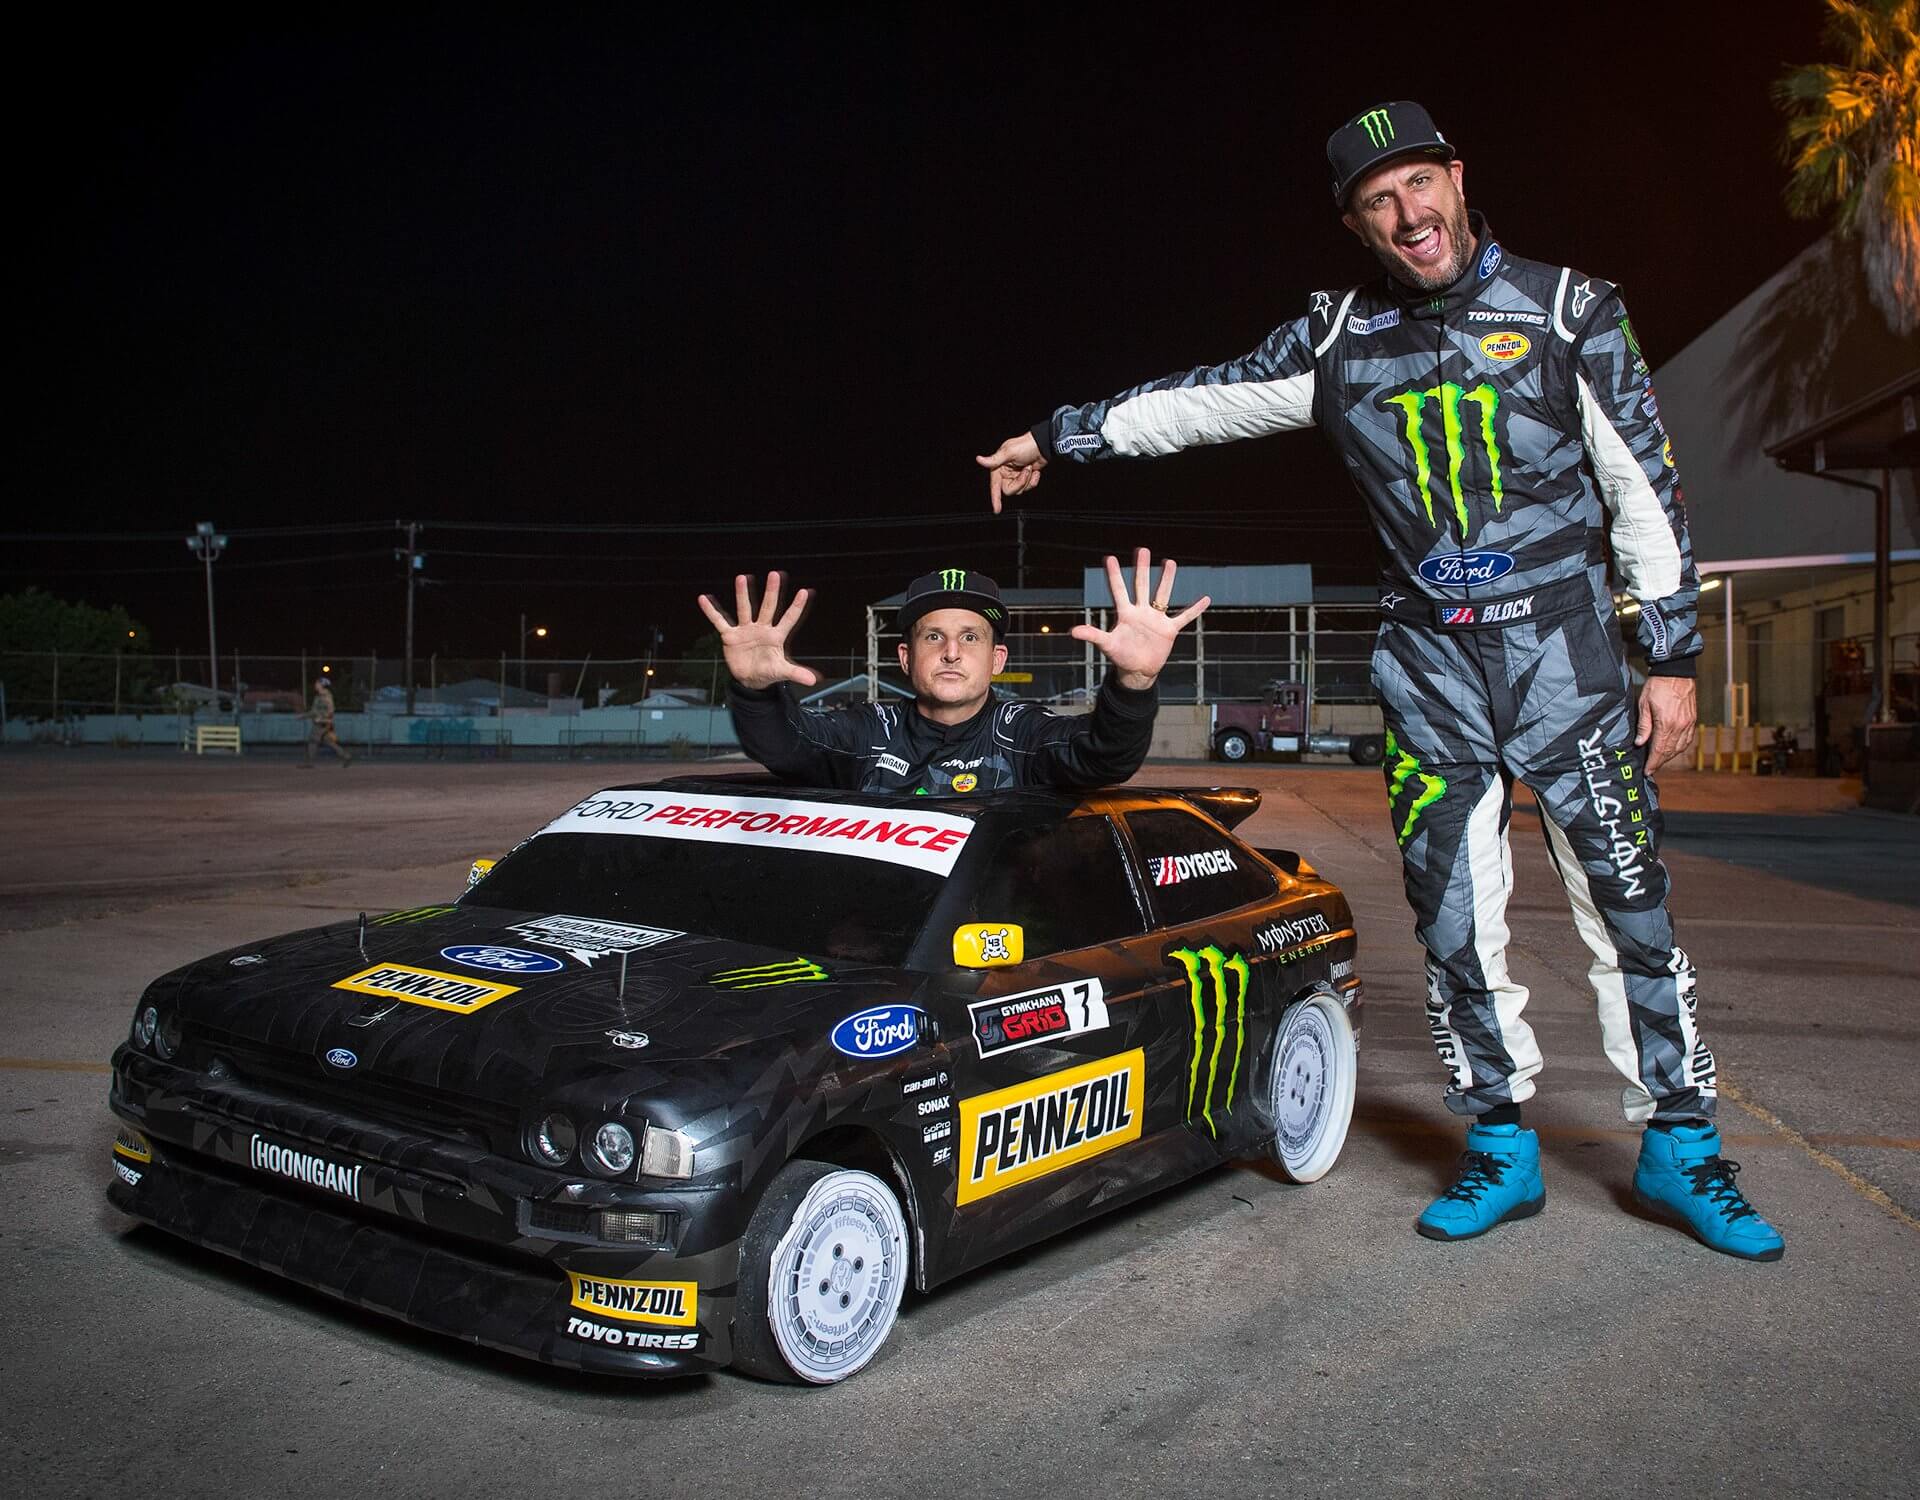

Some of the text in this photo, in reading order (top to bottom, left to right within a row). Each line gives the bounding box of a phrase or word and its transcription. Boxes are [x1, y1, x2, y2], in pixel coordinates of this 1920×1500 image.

[1467, 311, 1546, 325] TOYO TIRES
[1486, 340, 1522, 352] PENNZOIL
[1435, 553, 1495, 582] Ford
[1480, 595, 1535, 624] BLOCK
[643, 804, 970, 853] PERFORMANCE
[1177, 849, 1238, 881] DYRDEK
[352, 968, 499, 1007] PENNZOIL
[1001, 995, 1062, 1016] GYMKHANA
[1073, 983, 1089, 1027] 7
[853, 1011, 914, 1051] Ford
[918, 1096, 950, 1116] SONAX
[923, 1121, 951, 1135] GoPro
[970, 1067, 1134, 1184] PENNZOIL
[577, 1277, 688, 1318] PENNZOIL
[567, 1317, 700, 1349] TOYO TIRES
